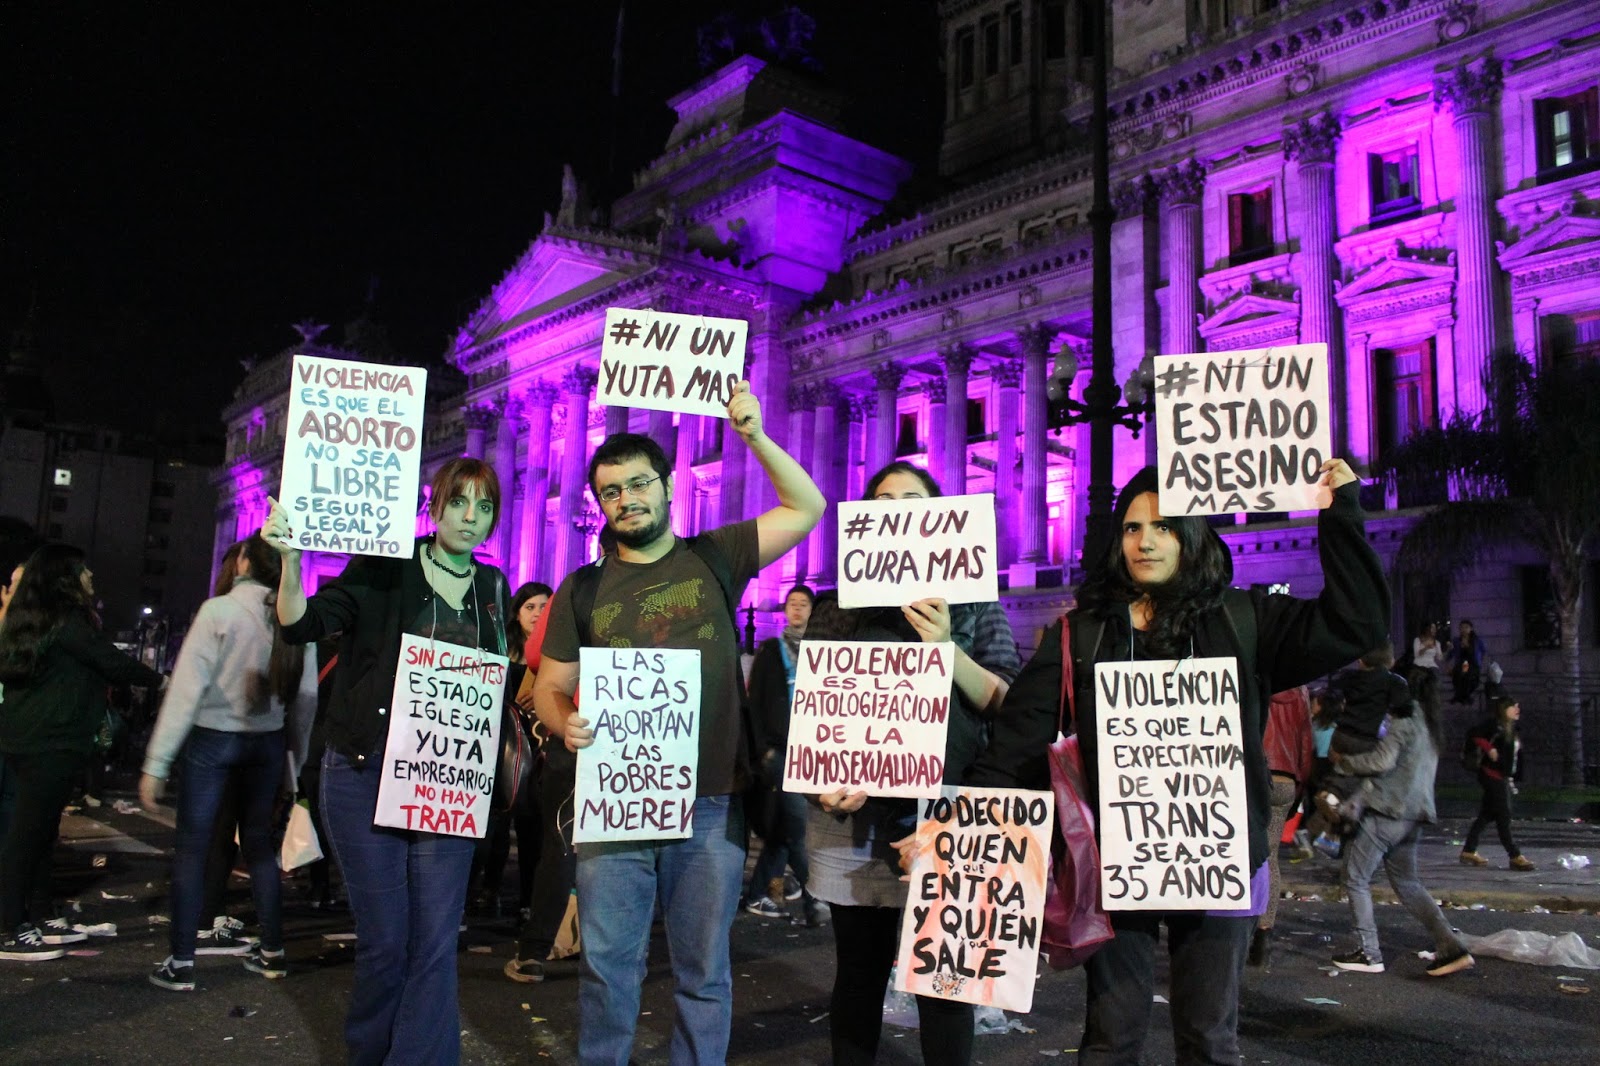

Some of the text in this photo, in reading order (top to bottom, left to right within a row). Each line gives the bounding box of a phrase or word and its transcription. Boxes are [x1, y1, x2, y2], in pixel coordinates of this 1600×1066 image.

[610, 318, 735, 357] #NI UN
[298, 362, 414, 396] VIOLENCIA
[603, 359, 738, 407] YUTA MAS
[1155, 356, 1313, 399] #NI UN
[301, 388, 405, 416] ES QUE EL
[298, 410, 416, 451] ABORTO
[1173, 399, 1318, 445] ESTADO
[305, 442, 401, 471] NO SEA
[1166, 444, 1322, 492] ASESINO
[311, 463, 400, 501] LIBRE
[295, 496, 390, 520] SEGURO
[1186, 492, 1276, 514] MAS
[305, 515, 390, 538] LEGAL Y
[844, 510, 969, 540] #NI UN
[300, 532, 400, 554] GRATUITO
[844, 545, 986, 584] CURA MAS
[405, 646, 504, 685] SIN CLIENTES
[612, 651, 665, 673] LAS
[806, 647, 945, 677] VIOLENCIA
[409, 672, 493, 710] ESTADO
[594, 675, 688, 704] RICAS
[823, 676, 914, 691] ES LA
[1100, 669, 1239, 709] VIOLENCIA
[409, 700, 492, 738] IGLESIA
[592, 703, 694, 743] ABORTAN
[794, 689, 948, 724] PATOLOGIZACION
[816, 724, 903, 745] DE LA
[1107, 715, 1231, 741] ES QUE LA
[416, 729, 483, 764] YUTA
[621, 743, 662, 762] LAS
[1114, 744, 1244, 770] EXPECTATIVA
[394, 760, 493, 795] EMPRESARIOS
[598, 762, 692, 794] POBRES
[788, 744, 944, 789] HOMOSEXUALIDAD
[415, 785, 477, 809] NO HAY
[1118, 772, 1229, 798] DE VIDA
[400, 805, 476, 836] TRATA
[953, 795, 1047, 827] DECIDO
[1109, 801, 1235, 842] TRANS
[935, 831, 1028, 864] QUIÉN
[1133, 842, 1232, 863] SEA DE
[921, 871, 1025, 909] ENTRA
[1104, 857, 1245, 901] 35 AÑOS
[913, 905, 1037, 949] Y QUIÉN
[912, 937, 1007, 980] SALE
